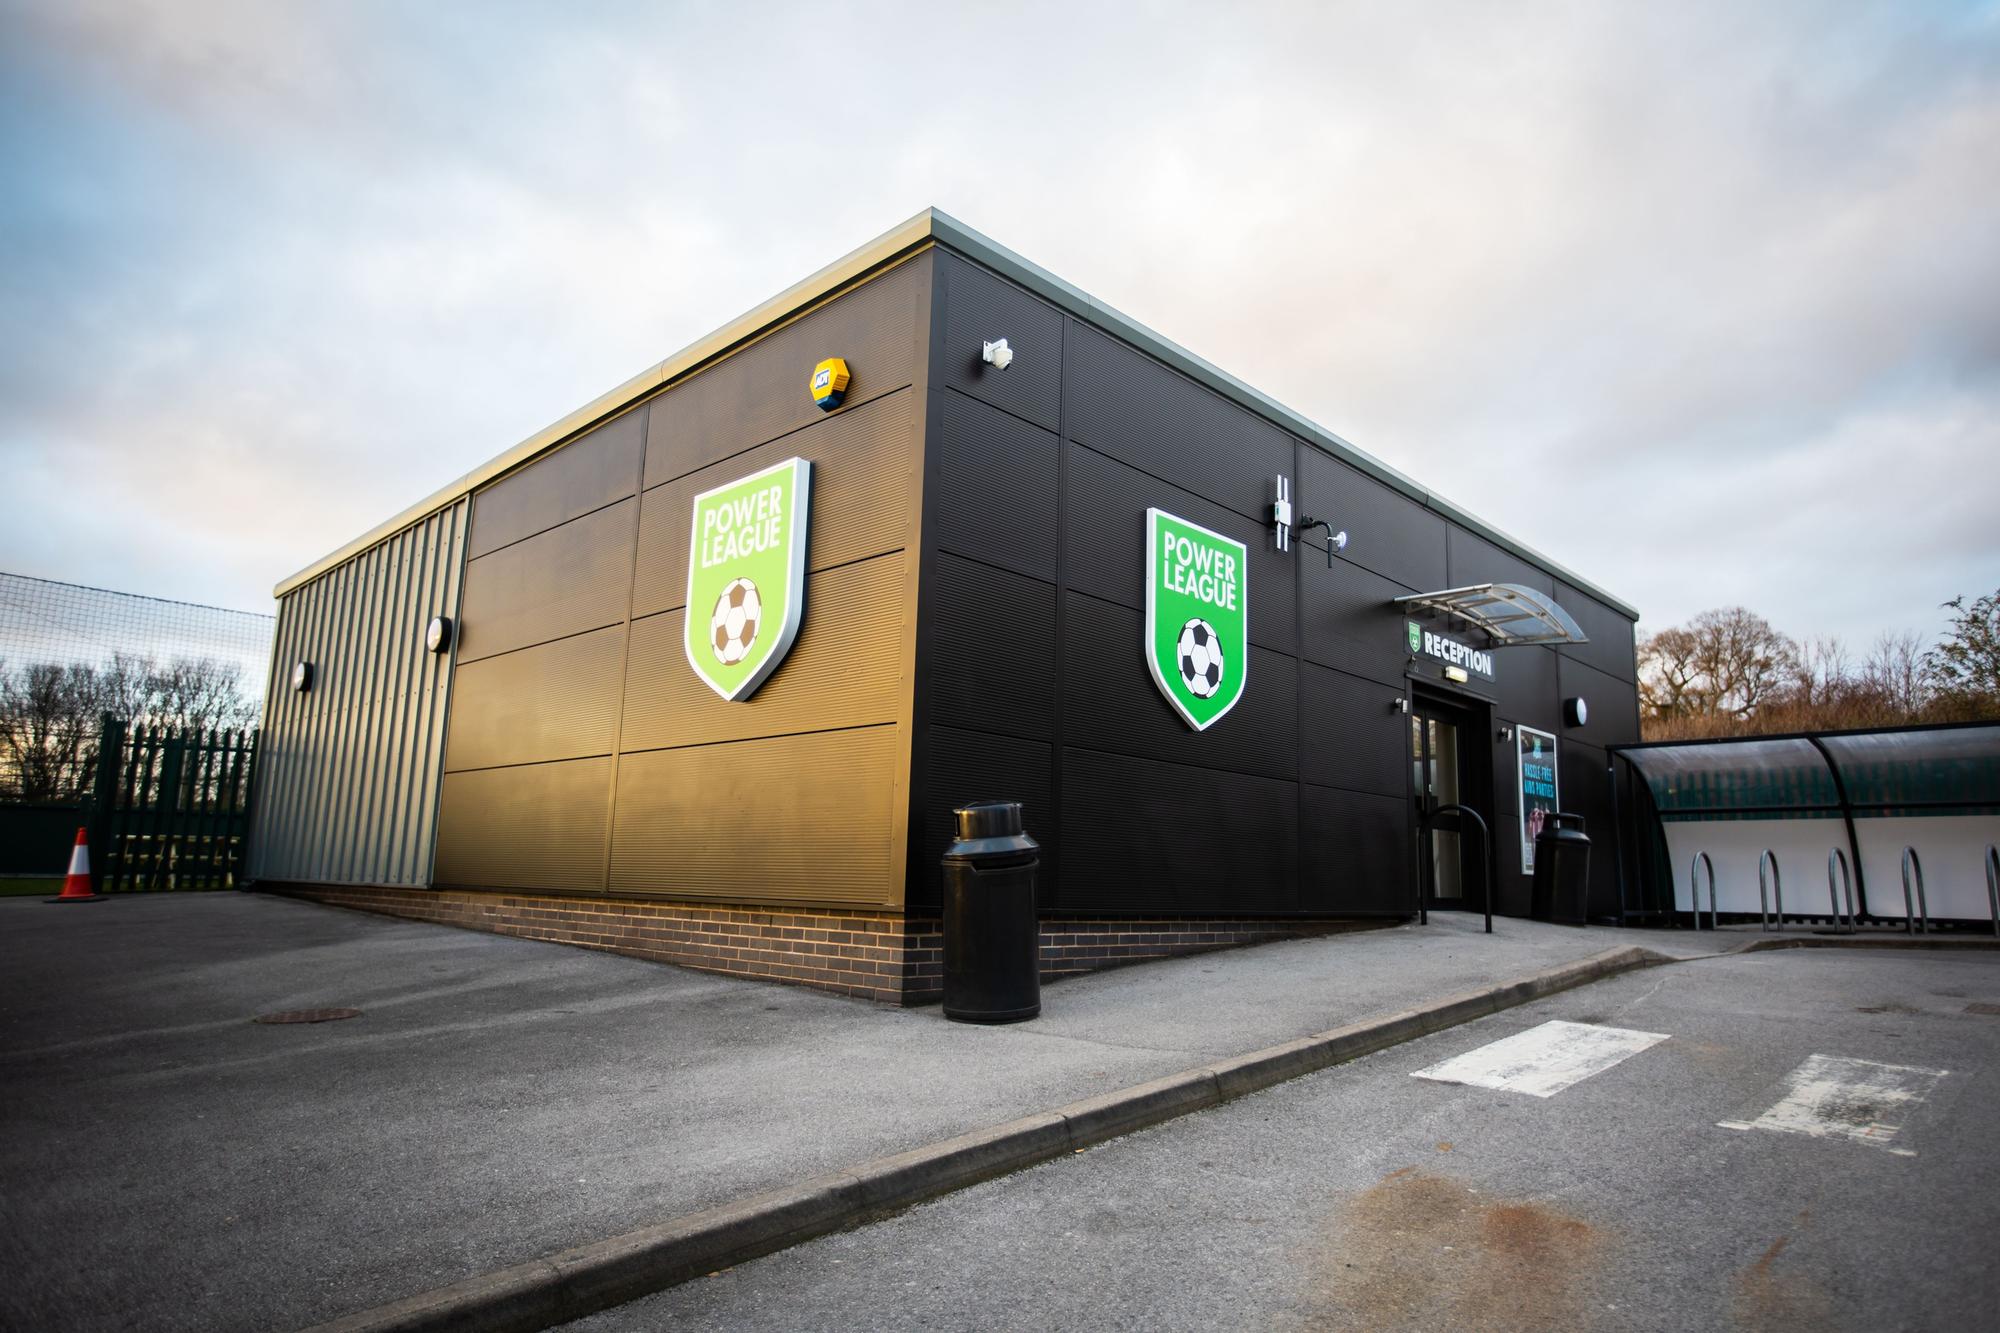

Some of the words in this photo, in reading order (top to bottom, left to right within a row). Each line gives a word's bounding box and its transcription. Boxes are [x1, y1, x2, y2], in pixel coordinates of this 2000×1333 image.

[703, 485, 783, 539] POWER
[701, 516, 781, 569] LEAGUE
[1164, 530, 1236, 583] POWER
[1164, 559, 1236, 612] LEAGUE
[1424, 631, 1492, 676] RECEPTION
